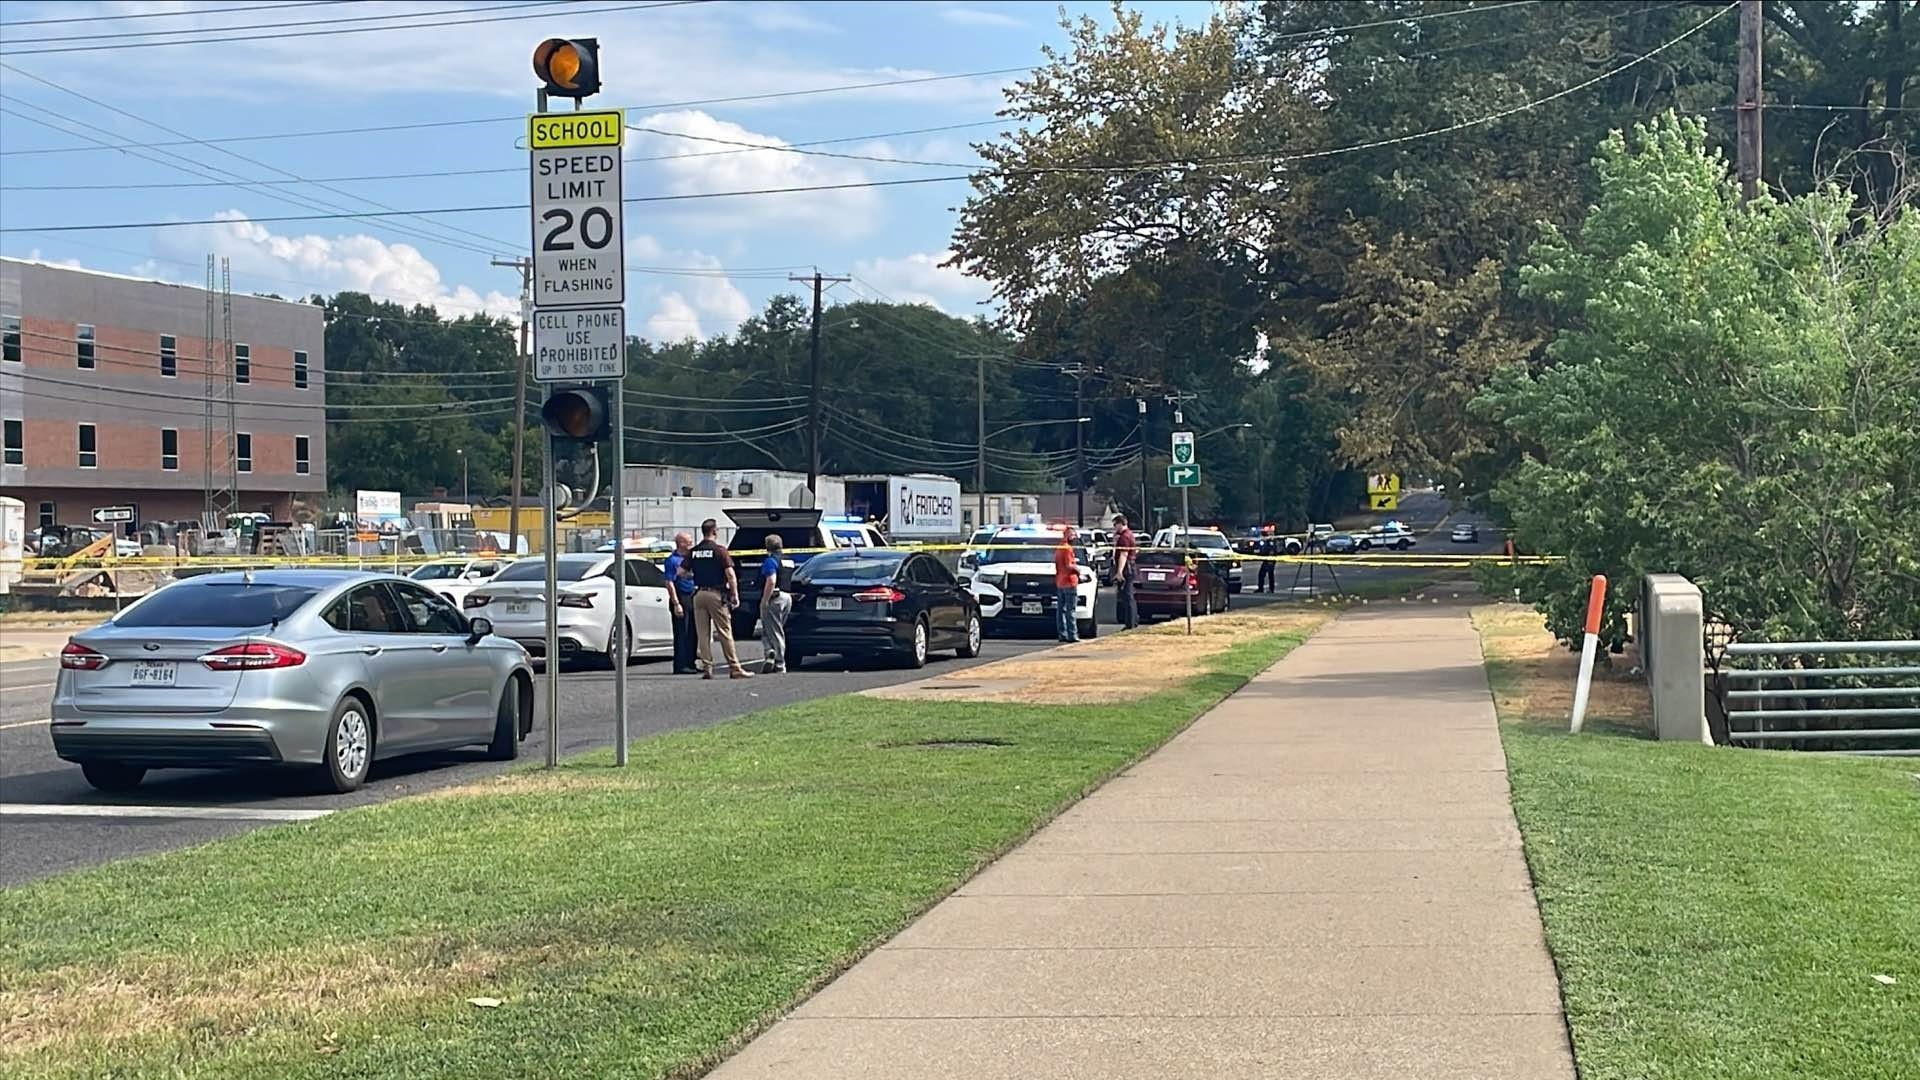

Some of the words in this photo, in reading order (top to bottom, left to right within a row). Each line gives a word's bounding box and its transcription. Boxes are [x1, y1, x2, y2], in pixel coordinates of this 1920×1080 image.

[536, 120, 615, 141] SCHOOL
[539, 155, 614, 176] SPEED
[548, 180, 606, 200] LIMIT
[542, 206, 614, 252] 20
[558, 258, 597, 272] WHEN
[544, 277, 613, 293] FLASHING
[539, 315, 568, 330] CELL
[577, 312, 618, 329] PHONE
[566, 330, 591, 346] USE
[540, 346, 618, 363] PROHIBITED
[541, 365, 552, 376] UP
[557, 364, 567, 375] TO
[600, 362, 617, 373] FINE
[916, 494, 953, 516] FRITCHER
[692, 550, 713, 559] POLICE
